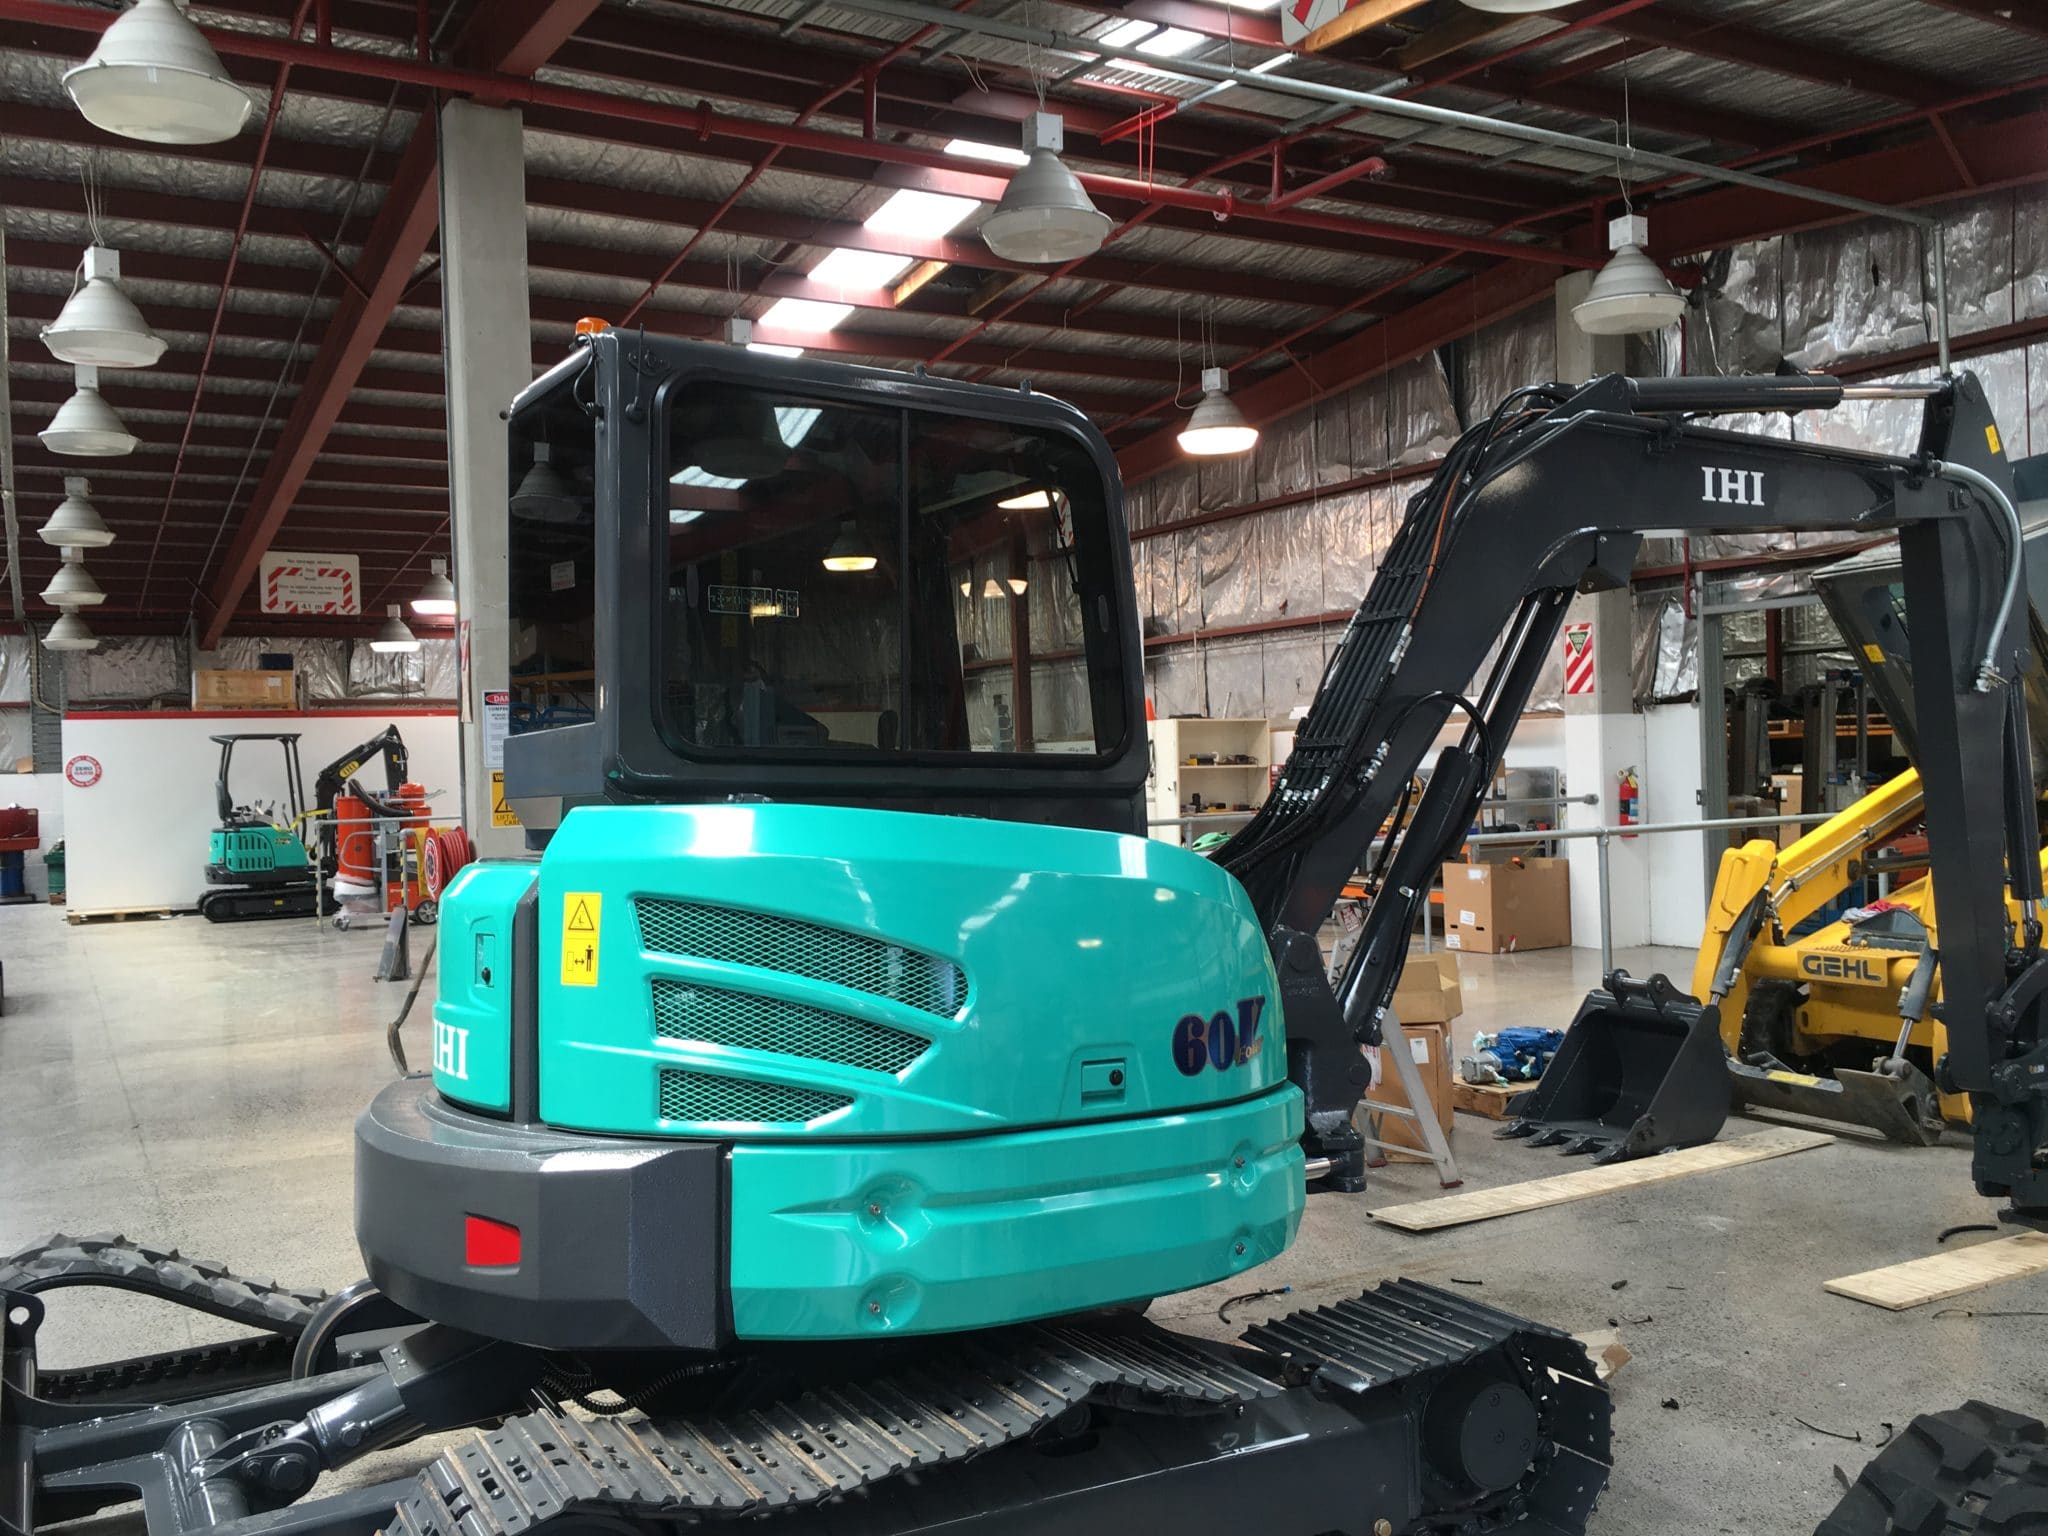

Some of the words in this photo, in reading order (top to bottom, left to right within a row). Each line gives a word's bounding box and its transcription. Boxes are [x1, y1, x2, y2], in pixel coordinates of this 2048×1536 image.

[1701, 466, 1765, 506] IHI
[494, 695, 509, 703] DAN
[1803, 954, 1881, 981] GEHL
[433, 1018, 469, 1081] IHI
